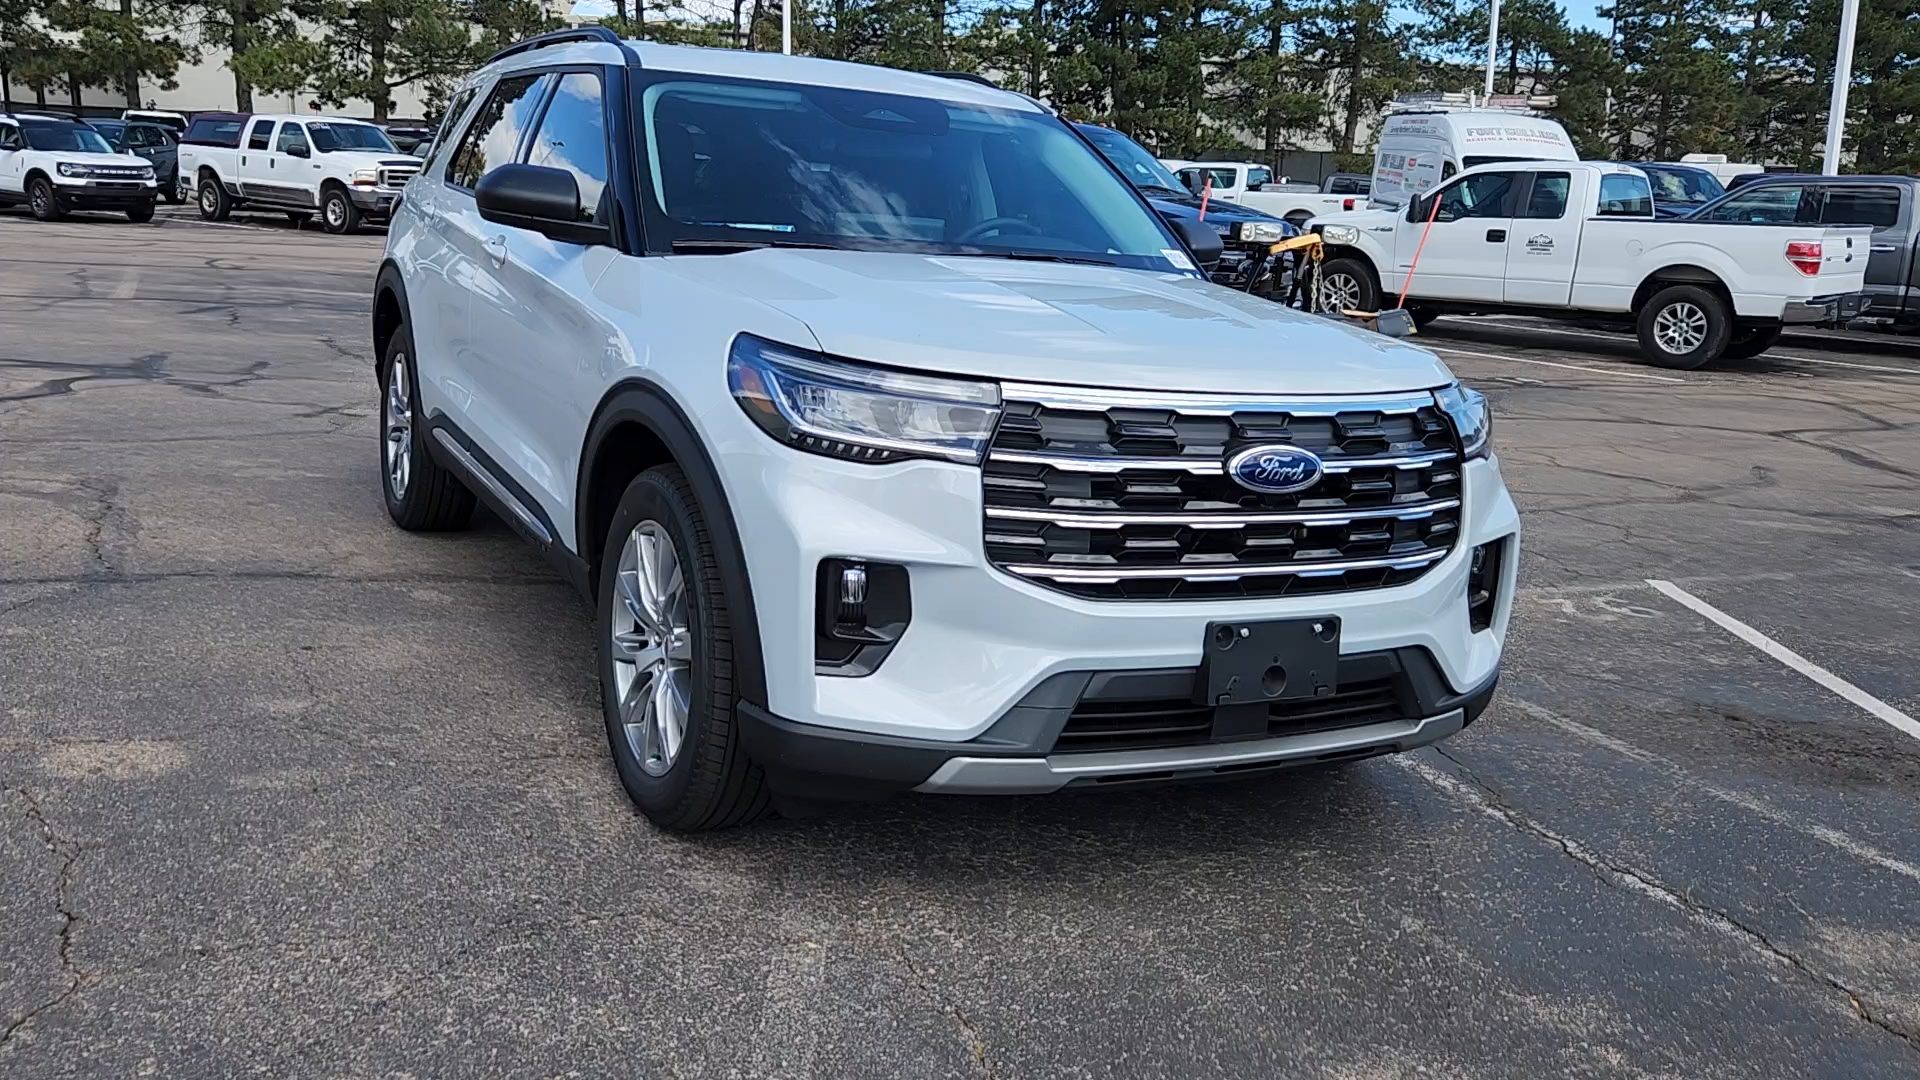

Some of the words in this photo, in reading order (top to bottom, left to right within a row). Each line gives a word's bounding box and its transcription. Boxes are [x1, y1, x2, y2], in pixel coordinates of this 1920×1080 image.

[1466, 127, 1502, 137] FORT
[1504, 127, 1560, 141] COLLINS
[1255, 455, 1306, 482] Ford
